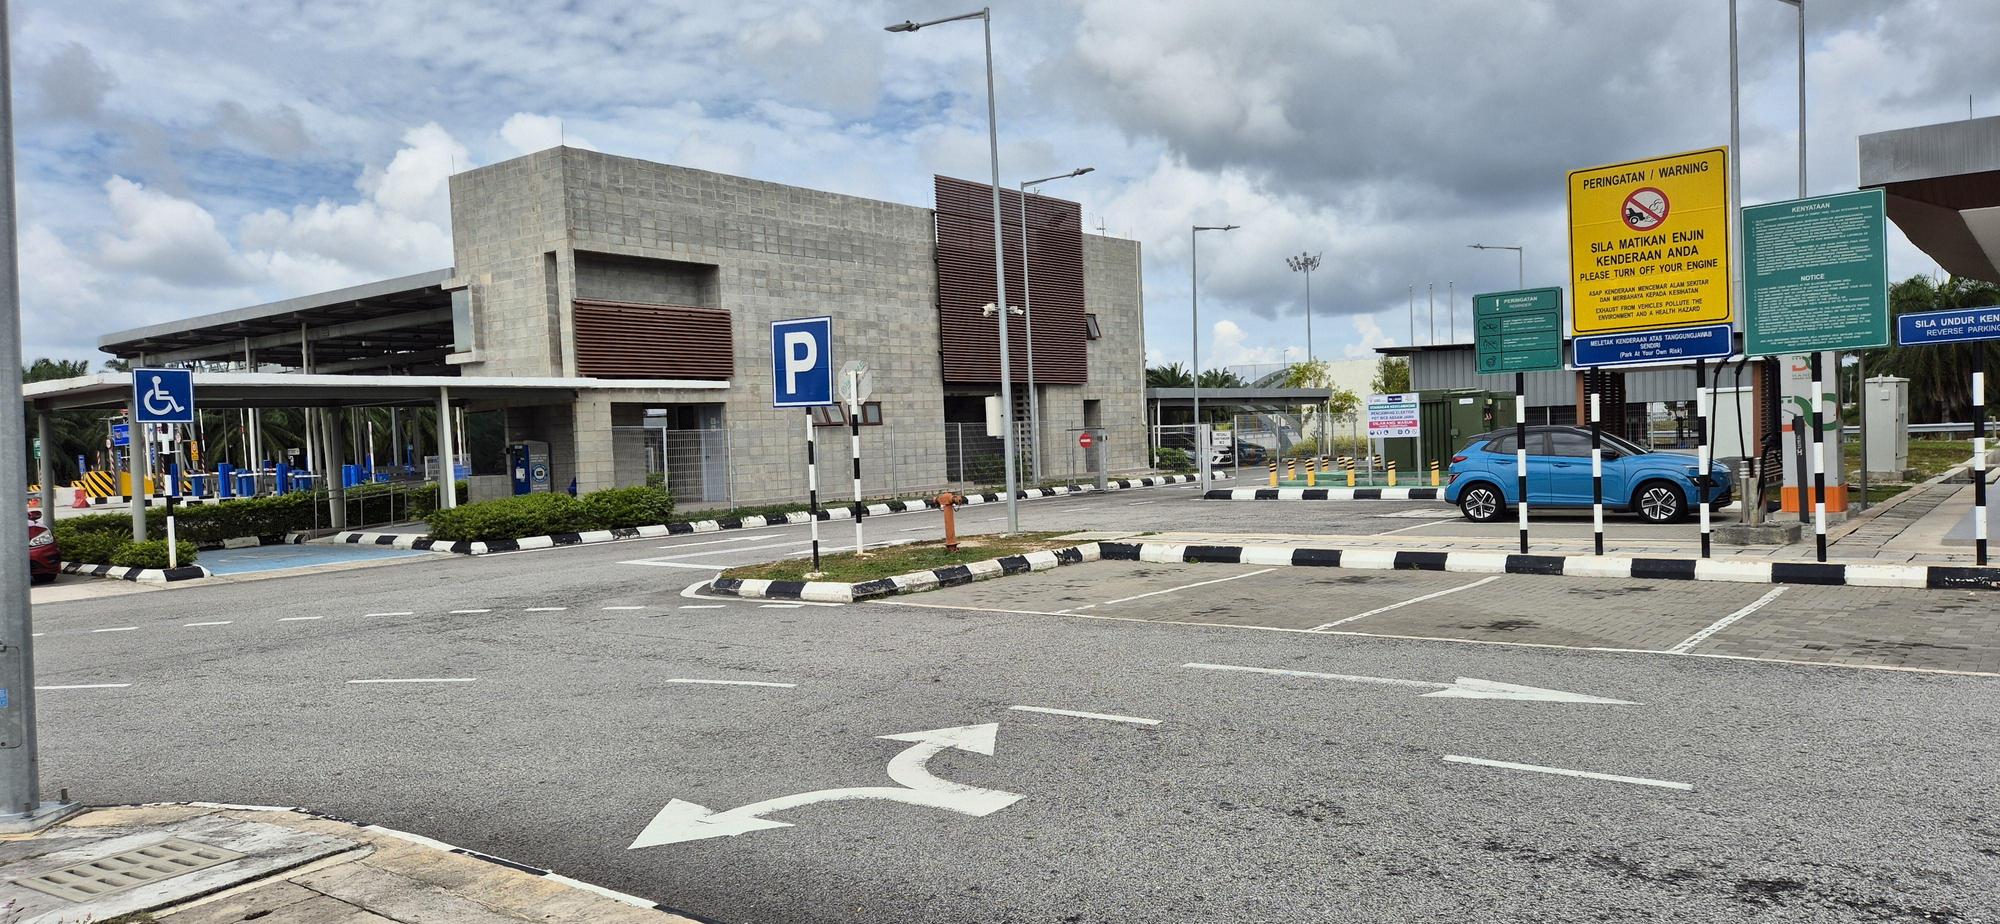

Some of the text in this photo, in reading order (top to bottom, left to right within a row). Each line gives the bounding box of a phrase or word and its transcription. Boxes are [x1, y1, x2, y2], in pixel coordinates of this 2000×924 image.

[1583, 161, 1709, 190] PERINGATAN / WARNING
[1791, 202, 1830, 213] KENYATAAN
[1591, 229, 1704, 253] SILA MATIKAN ENJIN
[1596, 245, 1699, 267] KENDERAAN ANDA
[1580, 258, 1718, 281] PLEASE TURN OFF YOUR ENGINE
[1800, 273, 1825, 282] NOTICE
[1605, 287, 1636, 296] KENDERAAN
[1638, 283, 1668, 293] MENCEMAR
[1669, 281, 1685, 289] ALAM
[1686, 279, 1709, 287] SEKITAR
[1645, 291, 1667, 299] KEPADA
[1668, 287, 1699, 296] KESIHATAN
[1638, 302, 1663, 310] VEHICLES
[1665, 299, 1690, 307] POLLUTE
[1598, 311, 1634, 321] ENVIRONMENT
[1678, 304, 1701, 313] HAZARD
[1914, 320, 1937, 329] SILA
[1940, 316, 1975, 327] UNDUR
[1590, 331, 1713, 347] MELETAK KENDERAAN ATAS TANGGUNGJAWAB
[1926, 327, 1964, 337] REVERSE
[1640, 342, 1661, 350] SENDIRI
[1642, 349, 1654, 357] Your
[1669, 347, 1683, 355] Risk)
[784, 331, 818, 395] P
